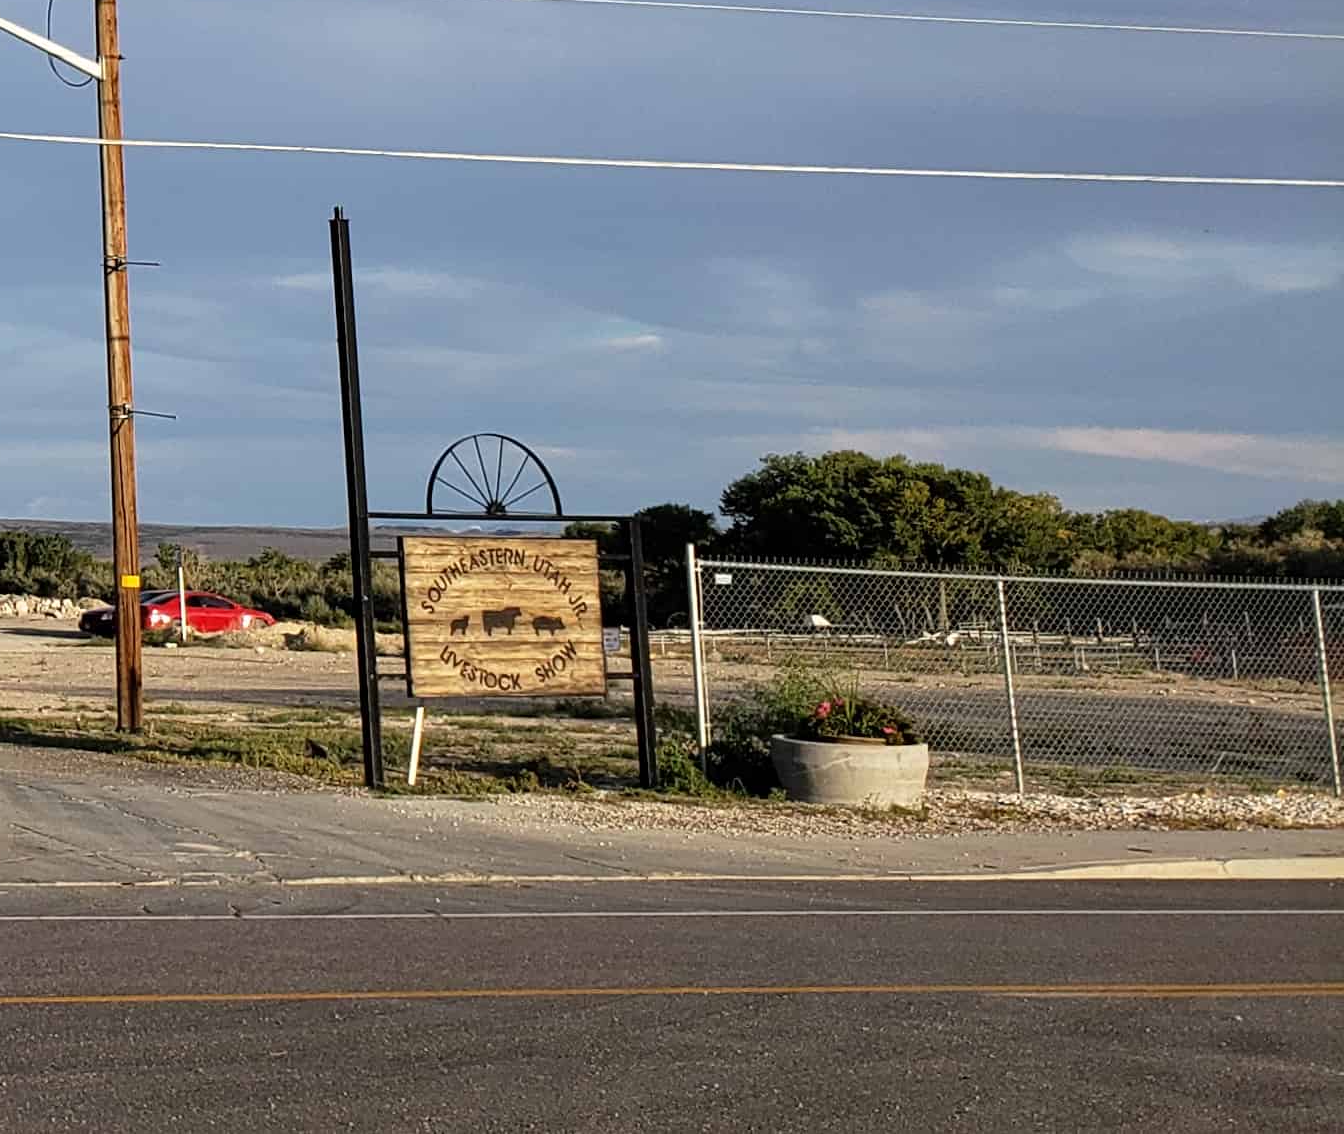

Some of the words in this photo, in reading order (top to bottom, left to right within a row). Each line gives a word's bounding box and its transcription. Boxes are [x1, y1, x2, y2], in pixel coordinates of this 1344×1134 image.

[421, 548, 525, 614] SOUTHEASTERN
[533, 555, 572, 595] UTAH
[439, 645, 522, 691] LIVESTOCK
[535, 639, 577, 683] SHOW
